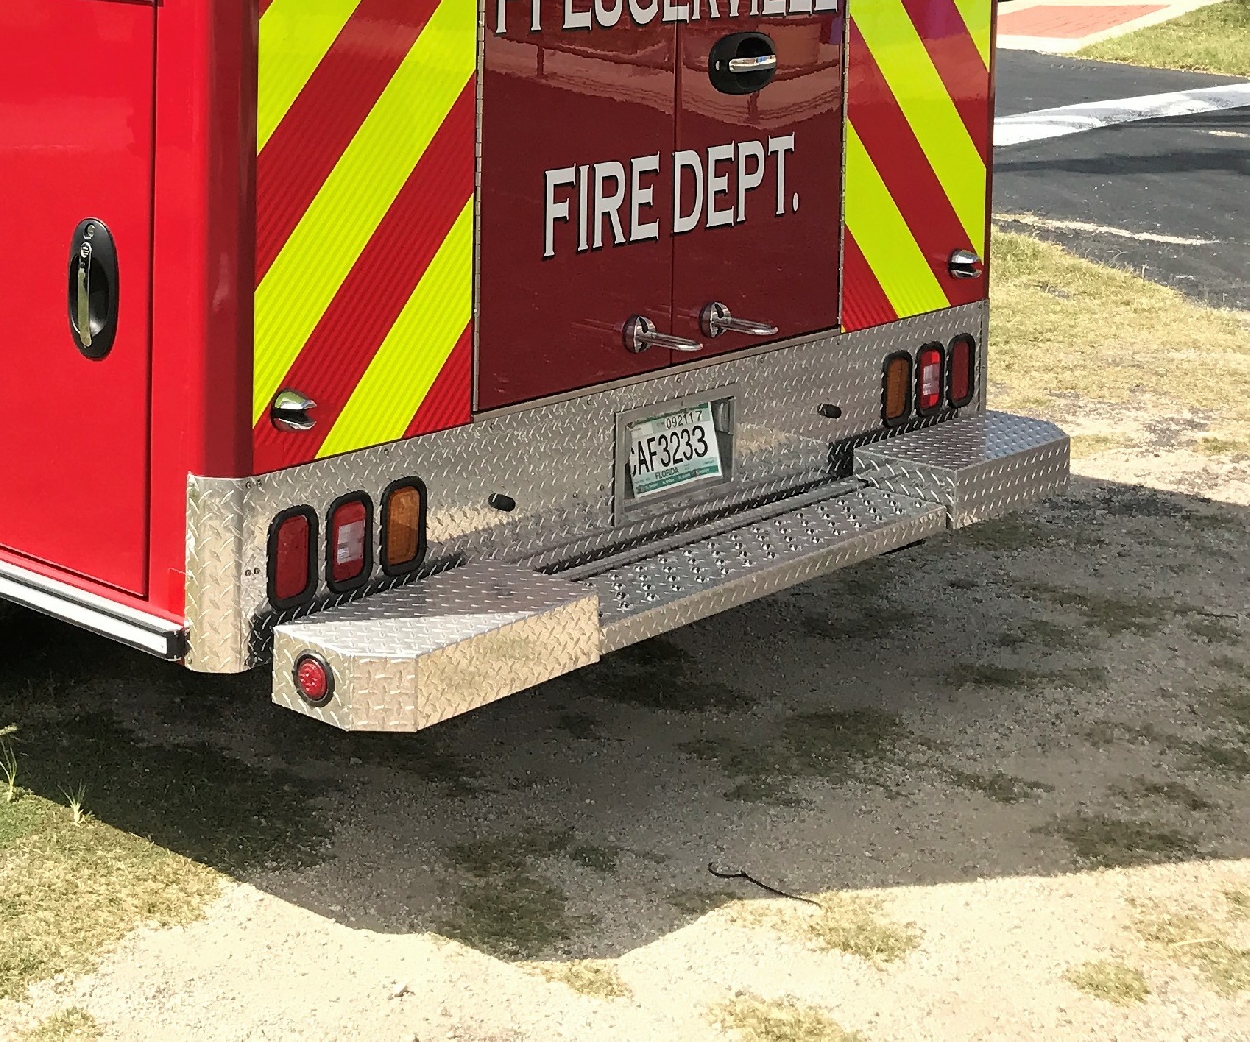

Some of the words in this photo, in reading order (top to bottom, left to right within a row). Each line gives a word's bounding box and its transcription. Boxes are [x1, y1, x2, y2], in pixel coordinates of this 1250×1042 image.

[541, 151, 661, 260] FIRE
[670, 132, 800, 238] DEPT.
[666, 410, 703, 429] 092117
[654, 466, 680, 480] FLORIDA
